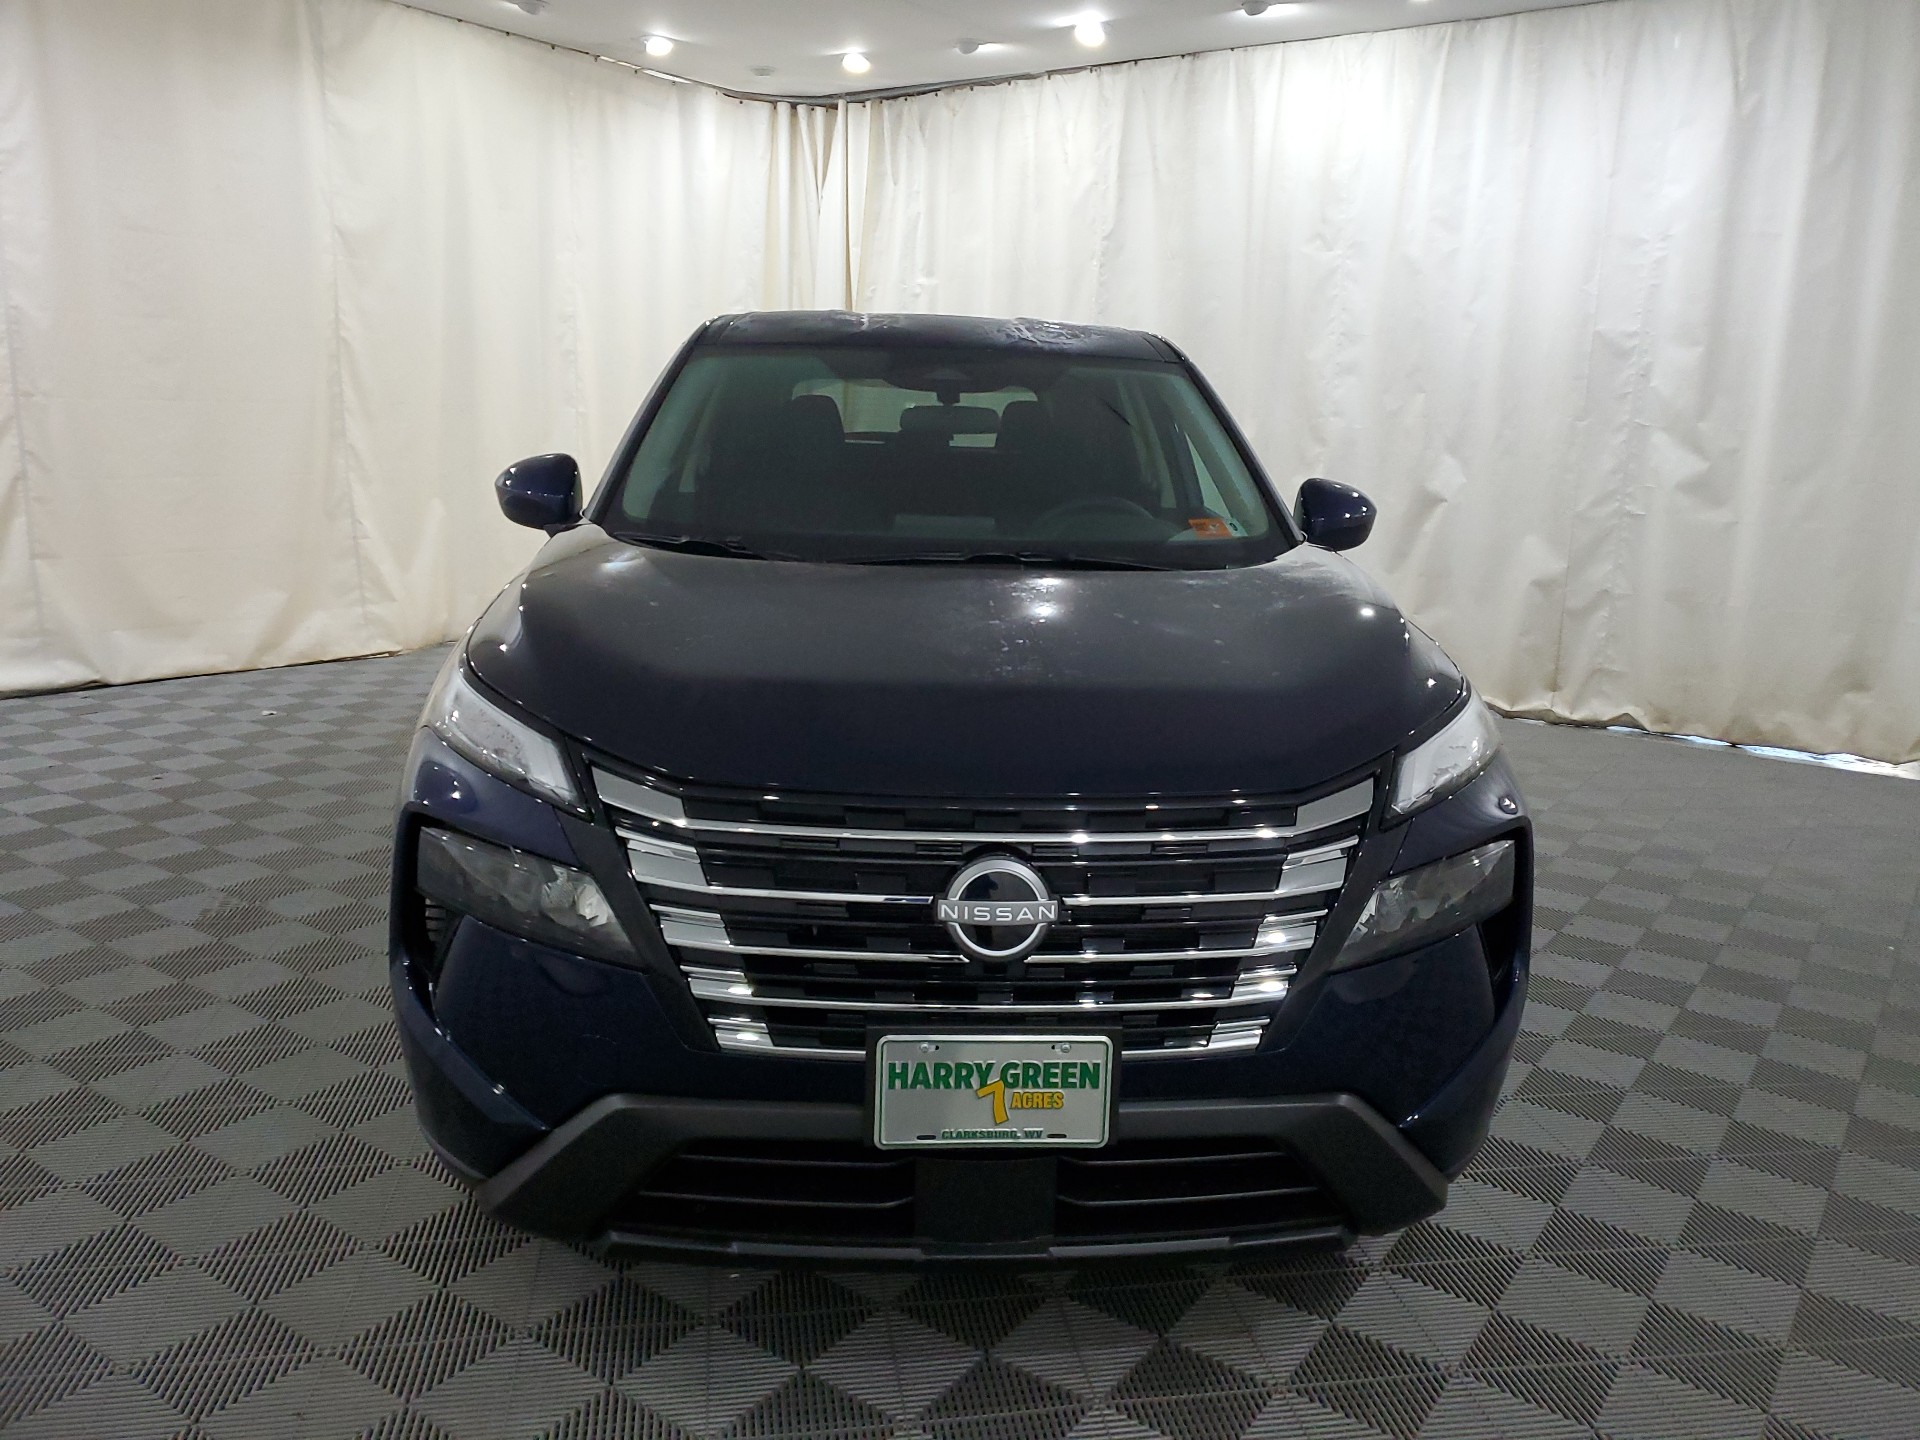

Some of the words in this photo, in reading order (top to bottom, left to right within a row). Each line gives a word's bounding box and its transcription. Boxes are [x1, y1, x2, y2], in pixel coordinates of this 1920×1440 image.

[940, 904, 1056, 922] NISSAN
[887, 1061, 996, 1089] HARRY
[1000, 1062, 1100, 1089] GREEN
[976, 1080, 1009, 1124] 7
[1010, 1091, 1064, 1109] ACRES
[1024, 1129, 1043, 1140] WV
